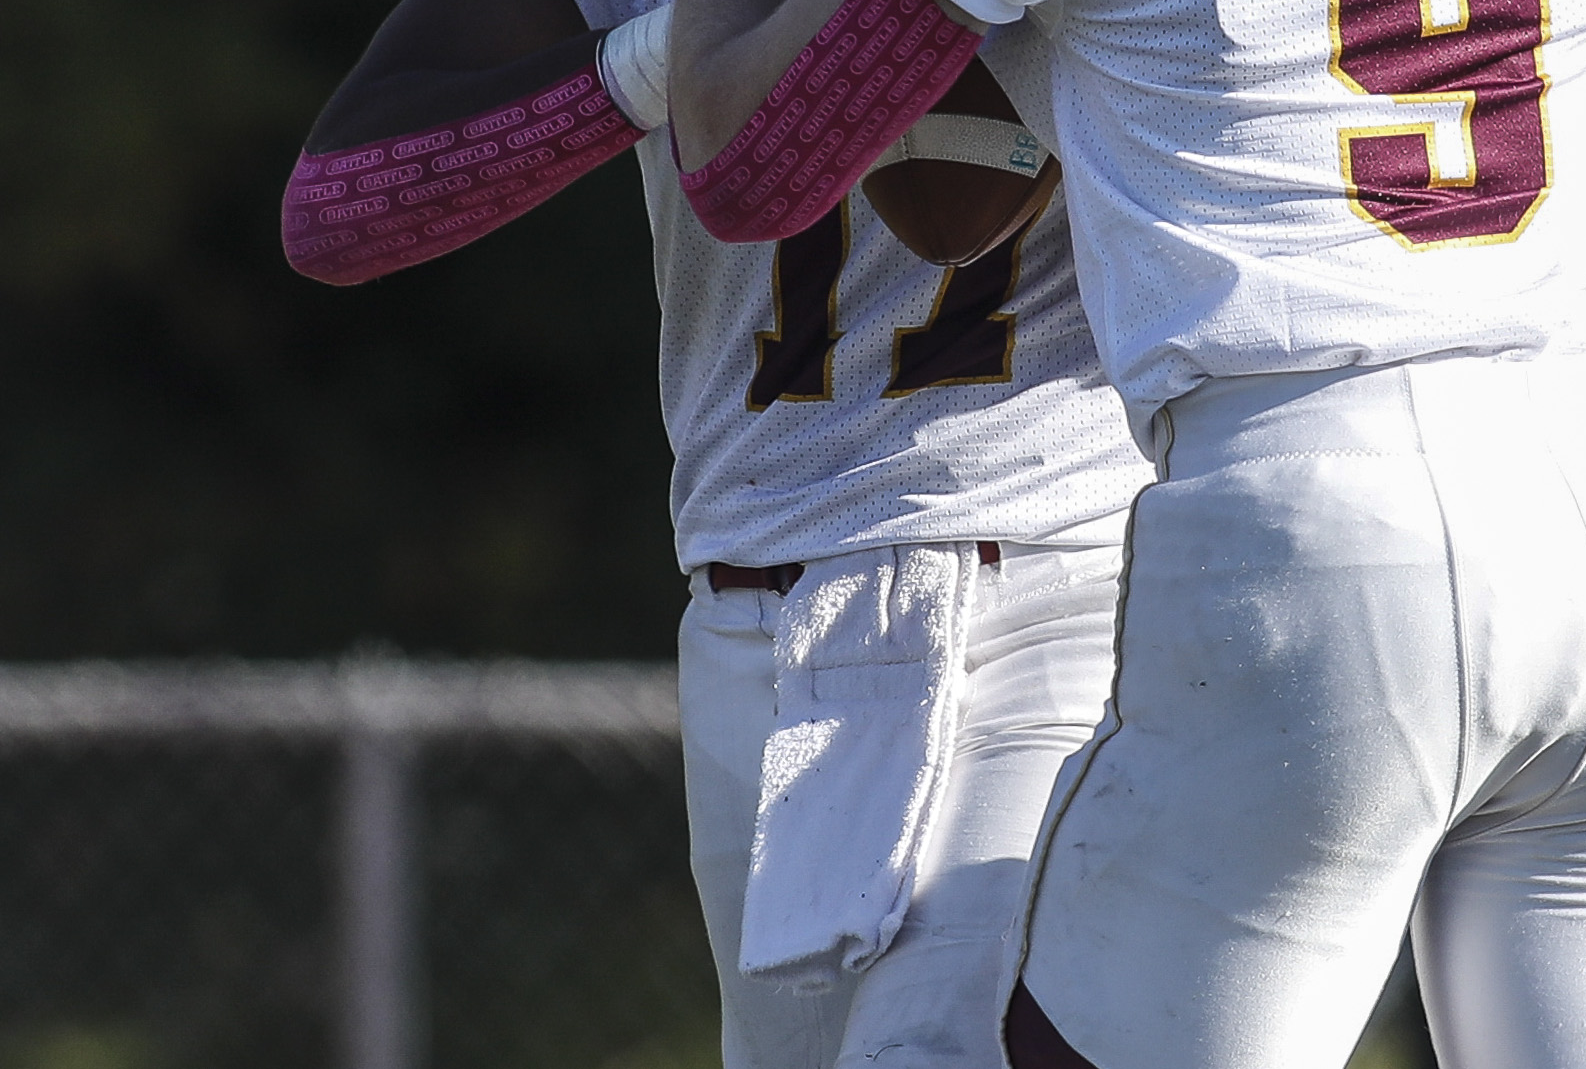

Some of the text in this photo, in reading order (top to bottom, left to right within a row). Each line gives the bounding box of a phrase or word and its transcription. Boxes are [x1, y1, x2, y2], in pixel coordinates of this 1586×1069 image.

[855, 20, 898, 72] BATTLE
[772, 49, 812, 101] BATTLE
[810, 37, 854, 90] BATTLE
[538, 77, 588, 110] BATTLE
[850, 69, 890, 119] BATTLE
[468, 110, 521, 135] BATTLE
[513, 115, 569, 145] BATTLE
[760, 101, 802, 158] BATTLE
[399, 133, 449, 157] BATTLE
[717, 114, 763, 168] BATTLE
[331, 150, 379, 173] BATTLE
[438, 144, 494, 169] BATTLE
[363, 166, 418, 190] BATTLE
[408, 177, 466, 202] BATTLE
[326, 198, 384, 222] BATTLE
